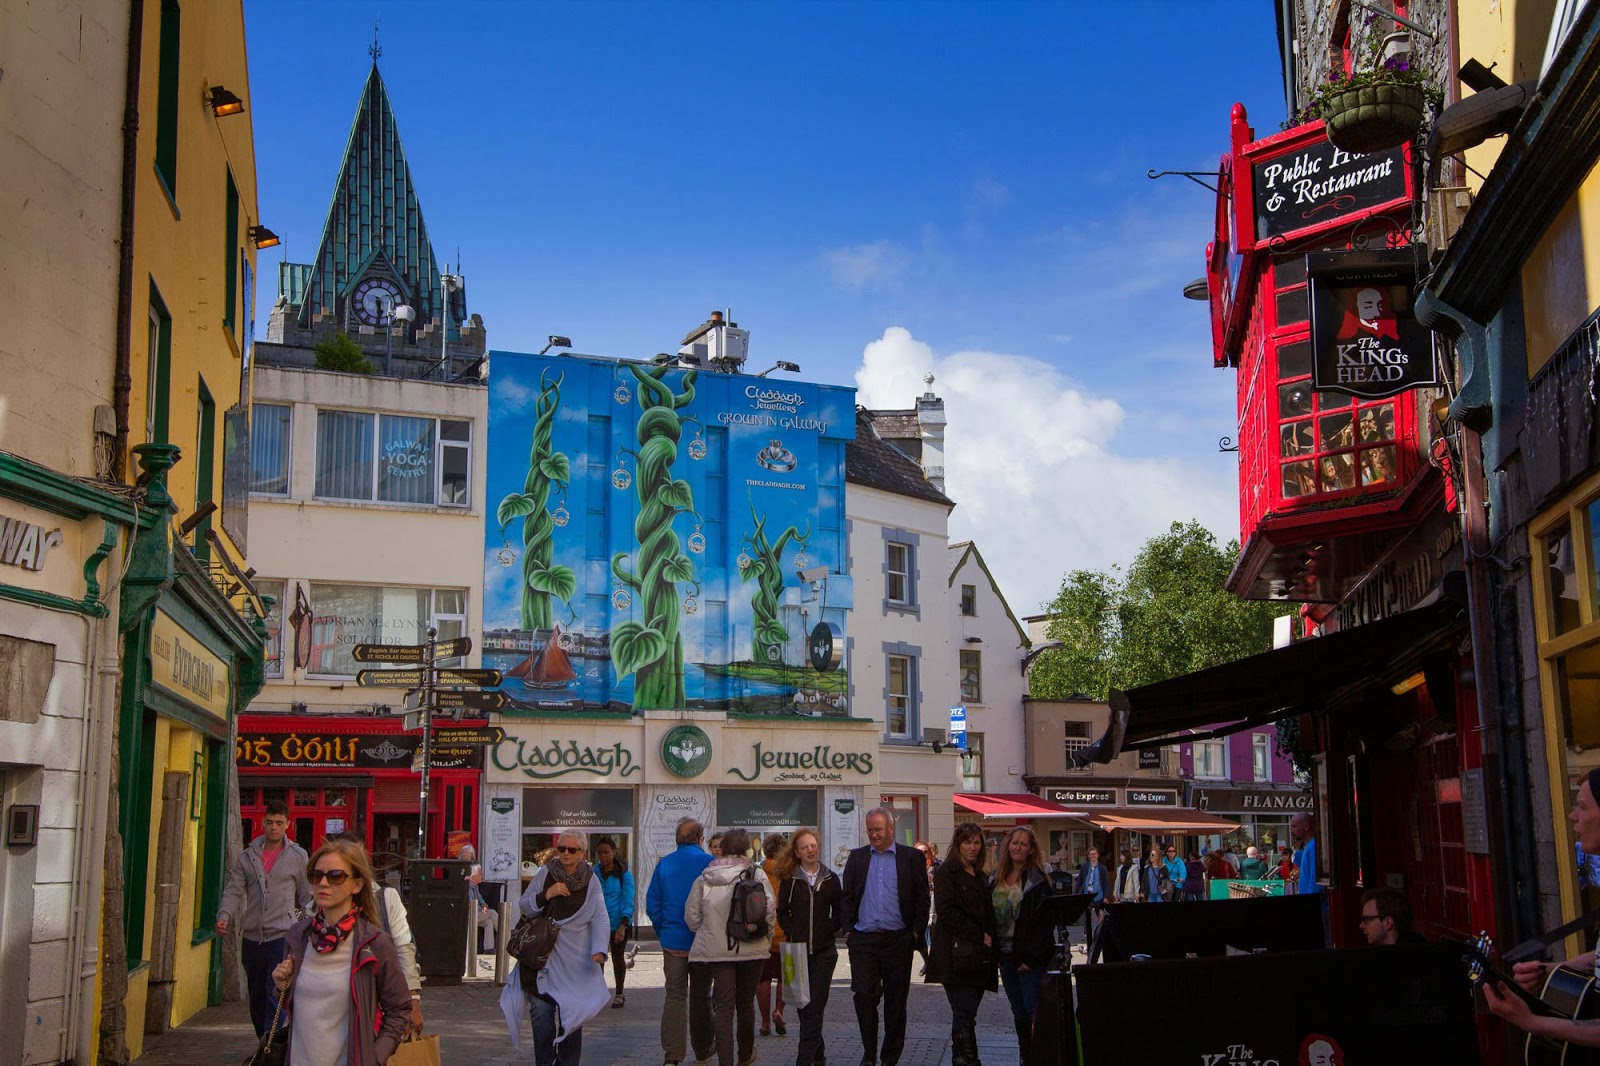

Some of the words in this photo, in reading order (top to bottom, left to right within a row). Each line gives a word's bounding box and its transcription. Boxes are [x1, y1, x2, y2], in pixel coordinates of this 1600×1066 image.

[1264, 153, 1322, 188] Public
[1266, 192, 1285, 212] &
[1292, 157, 1393, 204] Restaurant
[1358, 337, 1380, 349] The
[1337, 365, 1404, 383] HEAD
[745, 385, 805, 406] Claddagh
[750, 401, 796, 413] Jewellers
[766, 415, 777, 426] IN
[385, 440, 429, 453] GALWAY
[388, 453, 426, 465] YOGA
[387, 465, 426, 478] CENTRE
[316, 616, 365, 627] ADRIAN
[337, 634, 402, 645] SOLICITOR
[491, 737, 641, 779] Claddagh
[727, 741, 873, 781] Jewellers
[656, 794, 698, 805] Claddagh
[1056, 792, 1074, 800] Cafe
[1077, 792, 1109, 801] Express
[1133, 793, 1147, 801] Cafe
[1227, 1044, 1253, 1060] The
